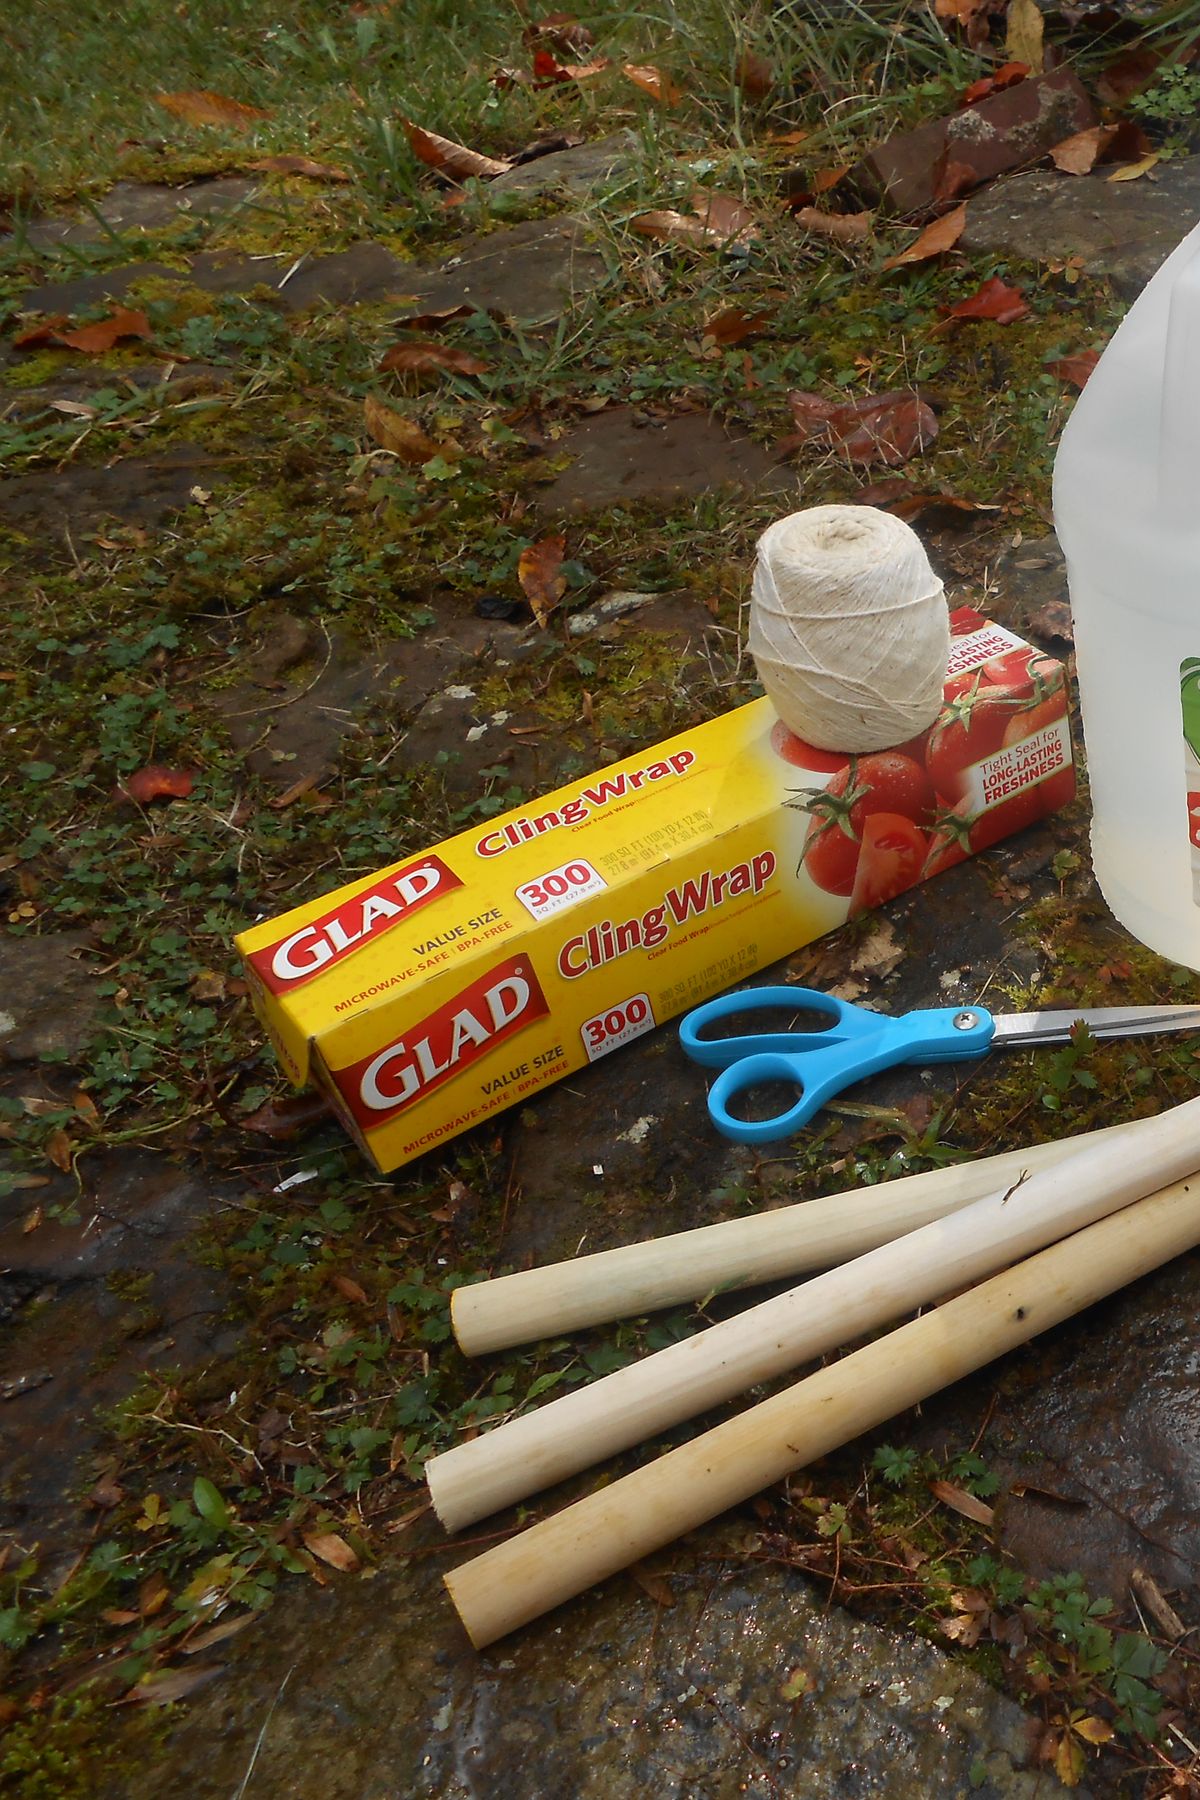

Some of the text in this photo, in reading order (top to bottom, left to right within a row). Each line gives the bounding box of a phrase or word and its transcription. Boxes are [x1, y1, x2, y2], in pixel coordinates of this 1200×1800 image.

[945, 641, 1014, 677] ESHNESS
[947, 636, 1003, 664] -LASTING
[949, 631, 992, 652] eal for
[980, 728, 1059, 775] Tight Seal for
[983, 739, 1062, 791] LONG-LASTING
[985, 753, 1064, 804] FRESHNESS
[571, 801, 635, 833] Clear Food Wrap
[522, 864, 591, 907] 300
[271, 866, 441, 980] GLAD
[413, 908, 503, 956] VALUE SIZE
[647, 926, 709, 960] Clear Food Wrap
[334, 920, 513, 1013] MICROWAVE-SAFE BPA-FREE
[360, 976, 530, 1111] GLAD
[585, 998, 647, 1046] 300
[481, 1045, 565, 1096] VALUE SIZE
[403, 1060, 569, 1155] MICROWAVE-SAFE BPA-FREE
